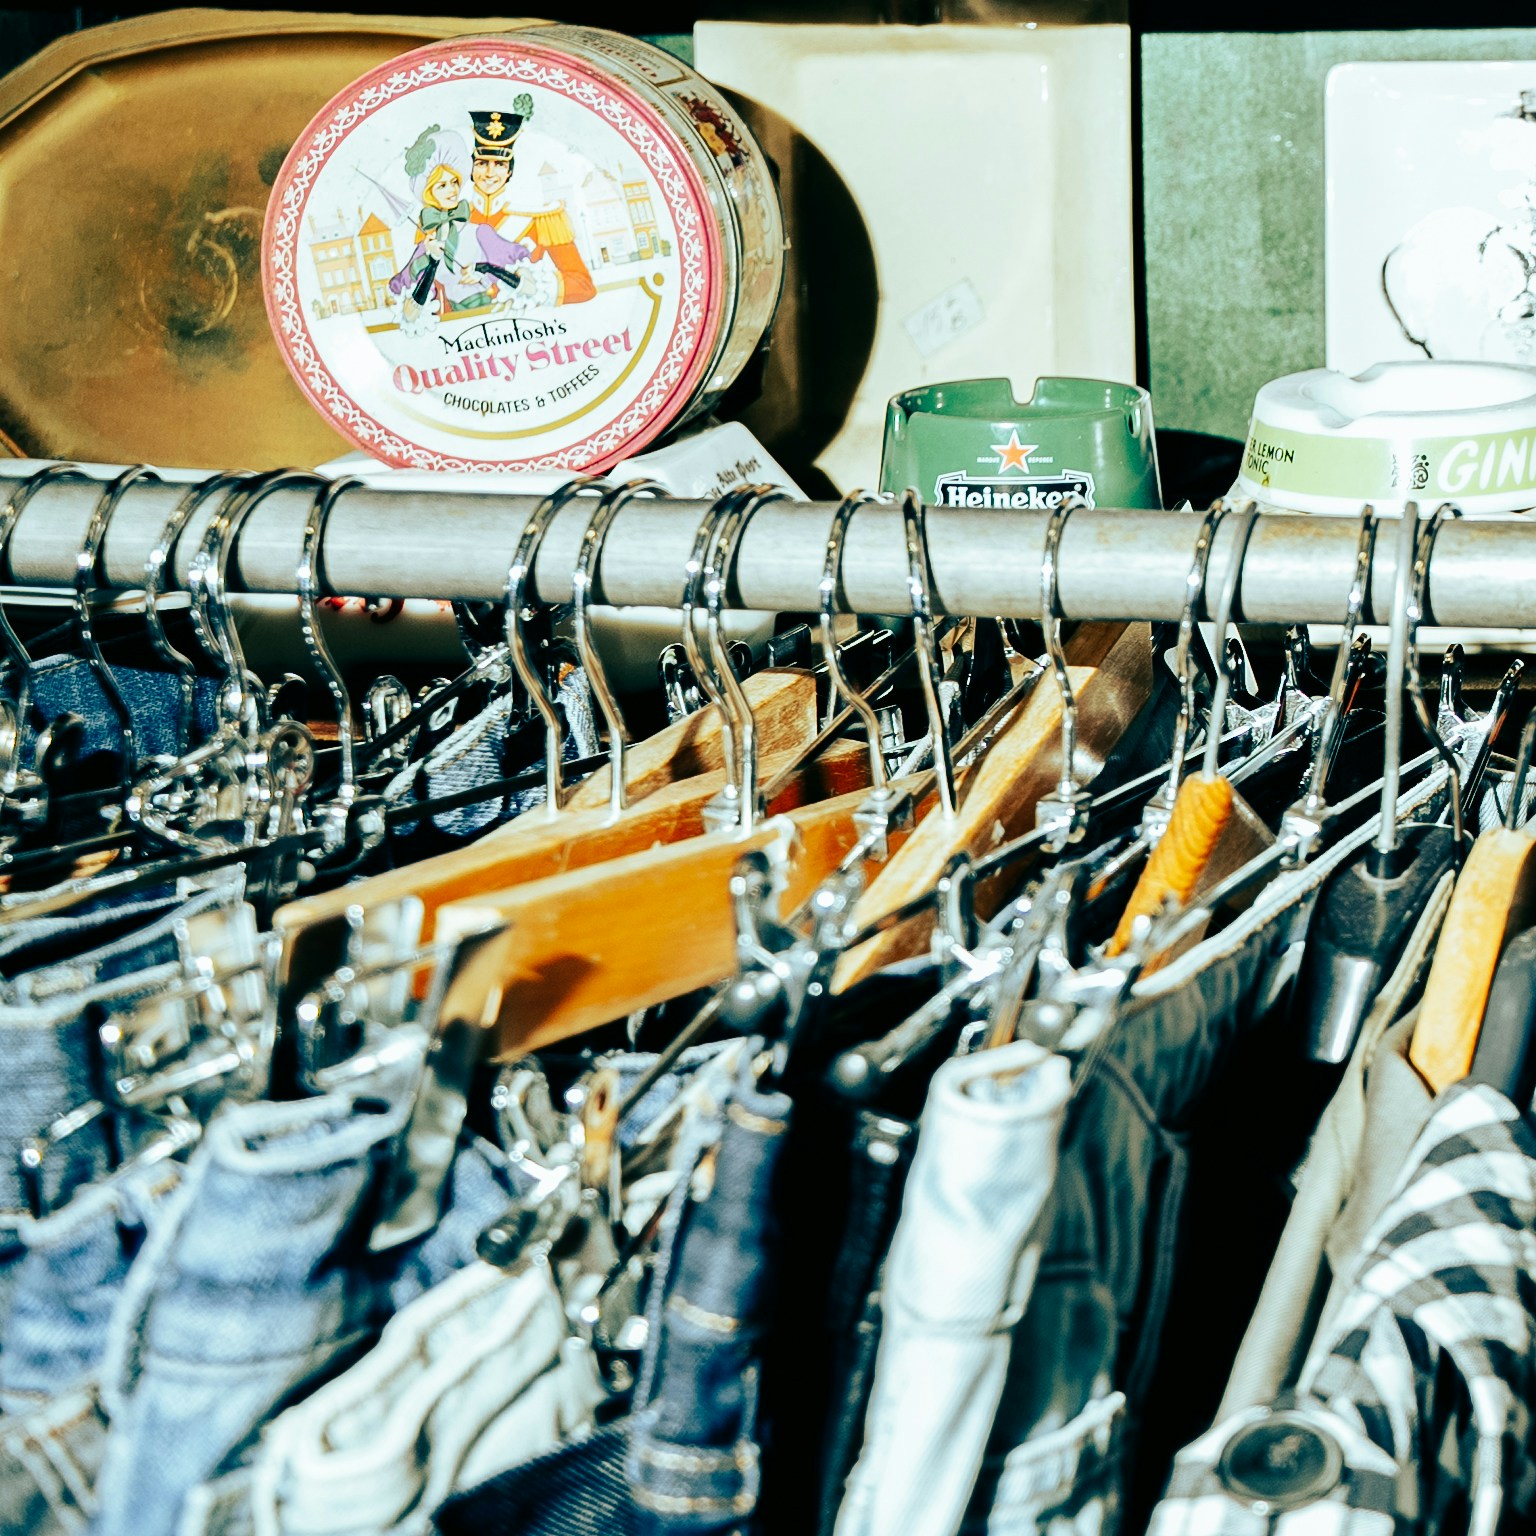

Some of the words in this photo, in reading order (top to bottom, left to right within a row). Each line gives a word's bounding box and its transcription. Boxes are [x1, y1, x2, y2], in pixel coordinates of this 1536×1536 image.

[438, 318, 567, 354] Mackintosh's
[392, 352, 519, 395] Quality
[525, 327, 633, 371] Street
[443, 392, 530, 414] CHOCOLATES
[535, 396, 545, 408] &
[550, 364, 600, 403] TOFFEES
[1258, 441, 1295, 464] LEMON
